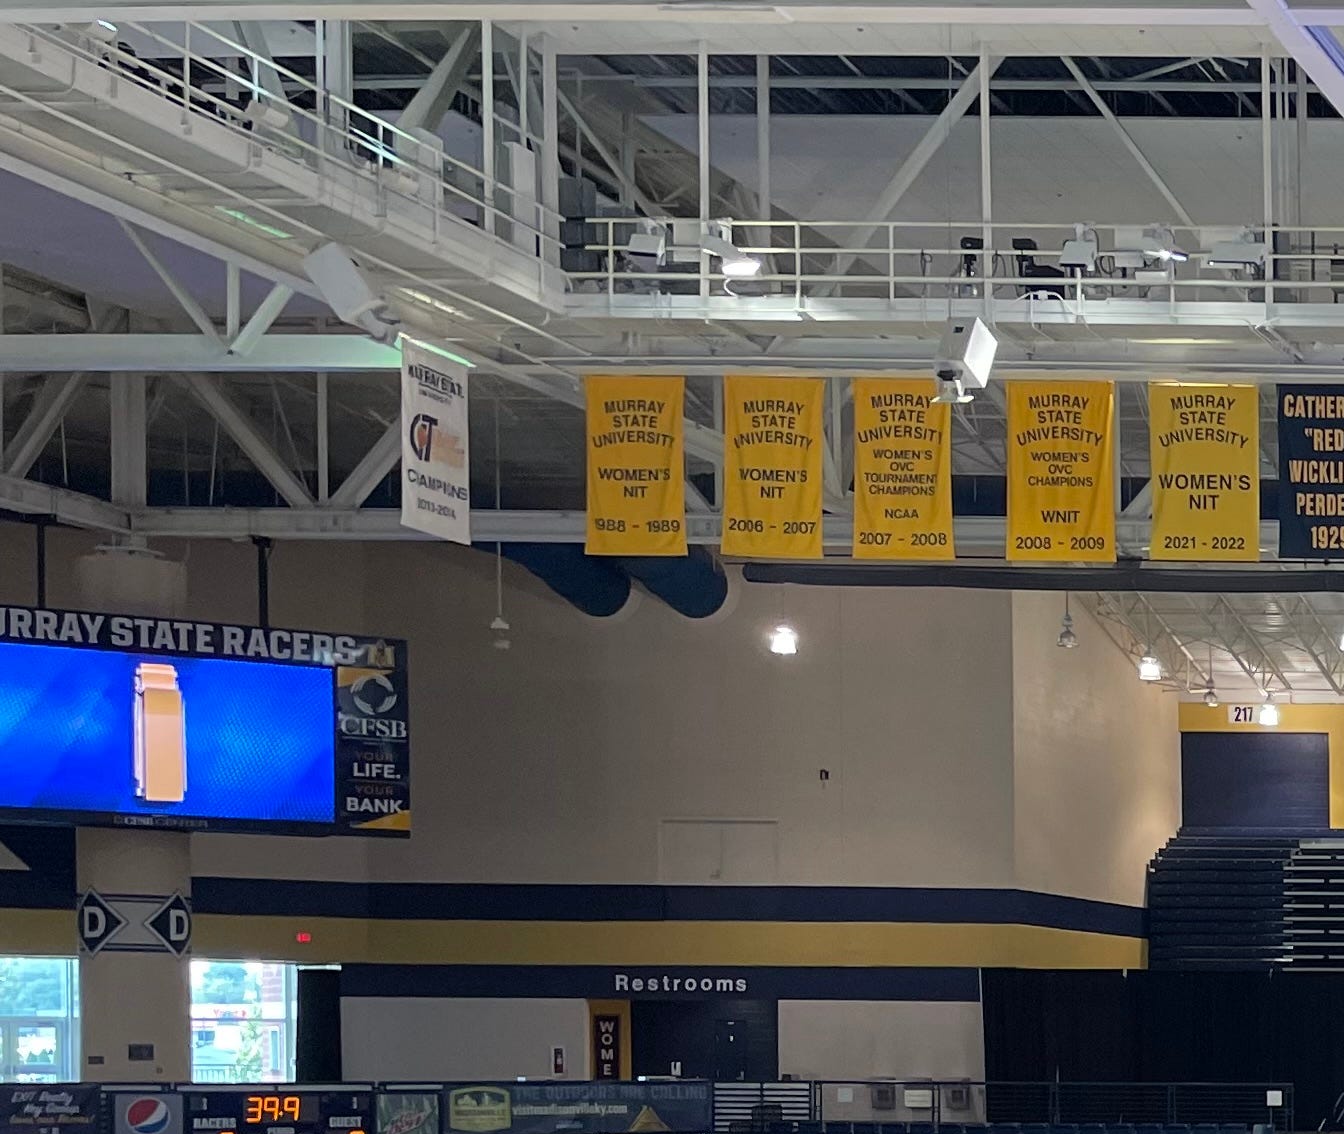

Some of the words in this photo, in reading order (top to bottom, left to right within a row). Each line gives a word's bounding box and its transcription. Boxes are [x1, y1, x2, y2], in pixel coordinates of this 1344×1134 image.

[605, 400, 665, 413] MURRAY
[744, 400, 804, 414] MURRAY
[871, 395, 933, 409] MURRAY
[1029, 395, 1089, 409] MURRAY
[1170, 395, 1236, 410] MURRAY
[613, 415, 657, 428] STATE
[752, 415, 796, 429] STATE
[880, 410, 924, 423] STATE
[1038, 412, 1082, 424] STATE
[1180, 412, 1226, 425] STATE
[1017, 426, 1103, 447] UNIVERSITY
[1158, 428, 1249, 448] UNIVERSITY
[873, 449, 932, 460] WOMEN'S
[1031, 451, 1089, 462] WOMEN'S
[890, 462, 914, 471] OVC
[1048, 464, 1072, 474] OVC
[598, 467, 670, 480] WOMEN'S
[1028, 476, 1093, 486] CHAMPIONS
[1159, 474, 1250, 490] WOMEN'S
[624, 486, 648, 498] NIT
[760, 487, 784, 498] NIT
[869, 485, 935, 496] CHAMPIONS
[1189, 495, 1219, 510] NIT
[885, 509, 918, 519] NCAA
[1041, 510, 1080, 523] WNIT
[595, 519, 626, 532] 1988
[647, 520, 680, 532] 1989
[729, 519, 763, 532] 2006
[783, 521, 816, 534] 2007
[860, 532, 892, 545] 2007
[911, 533, 947, 545] 2008
[1016, 537, 1051, 549] 2008
[1070, 537, 1105, 550] 2009
[1165, 536, 1196, 549] 2021
[1212, 537, 1245, 549] 2022
[111, 616, 216, 654] STATE
[223, 625, 357, 666] RACERS
[1234, 706, 1253, 722] 217
[340, 717, 407, 738] CFSB
[353, 762, 401, 779] LIFE.
[346, 797, 402, 813] BANK
[615, 974, 748, 993] Restrooms
[246, 1096, 301, 1124] 39.9
[193, 1117, 237, 1129] RACERS
[329, 1116, 362, 1128] GUEST
